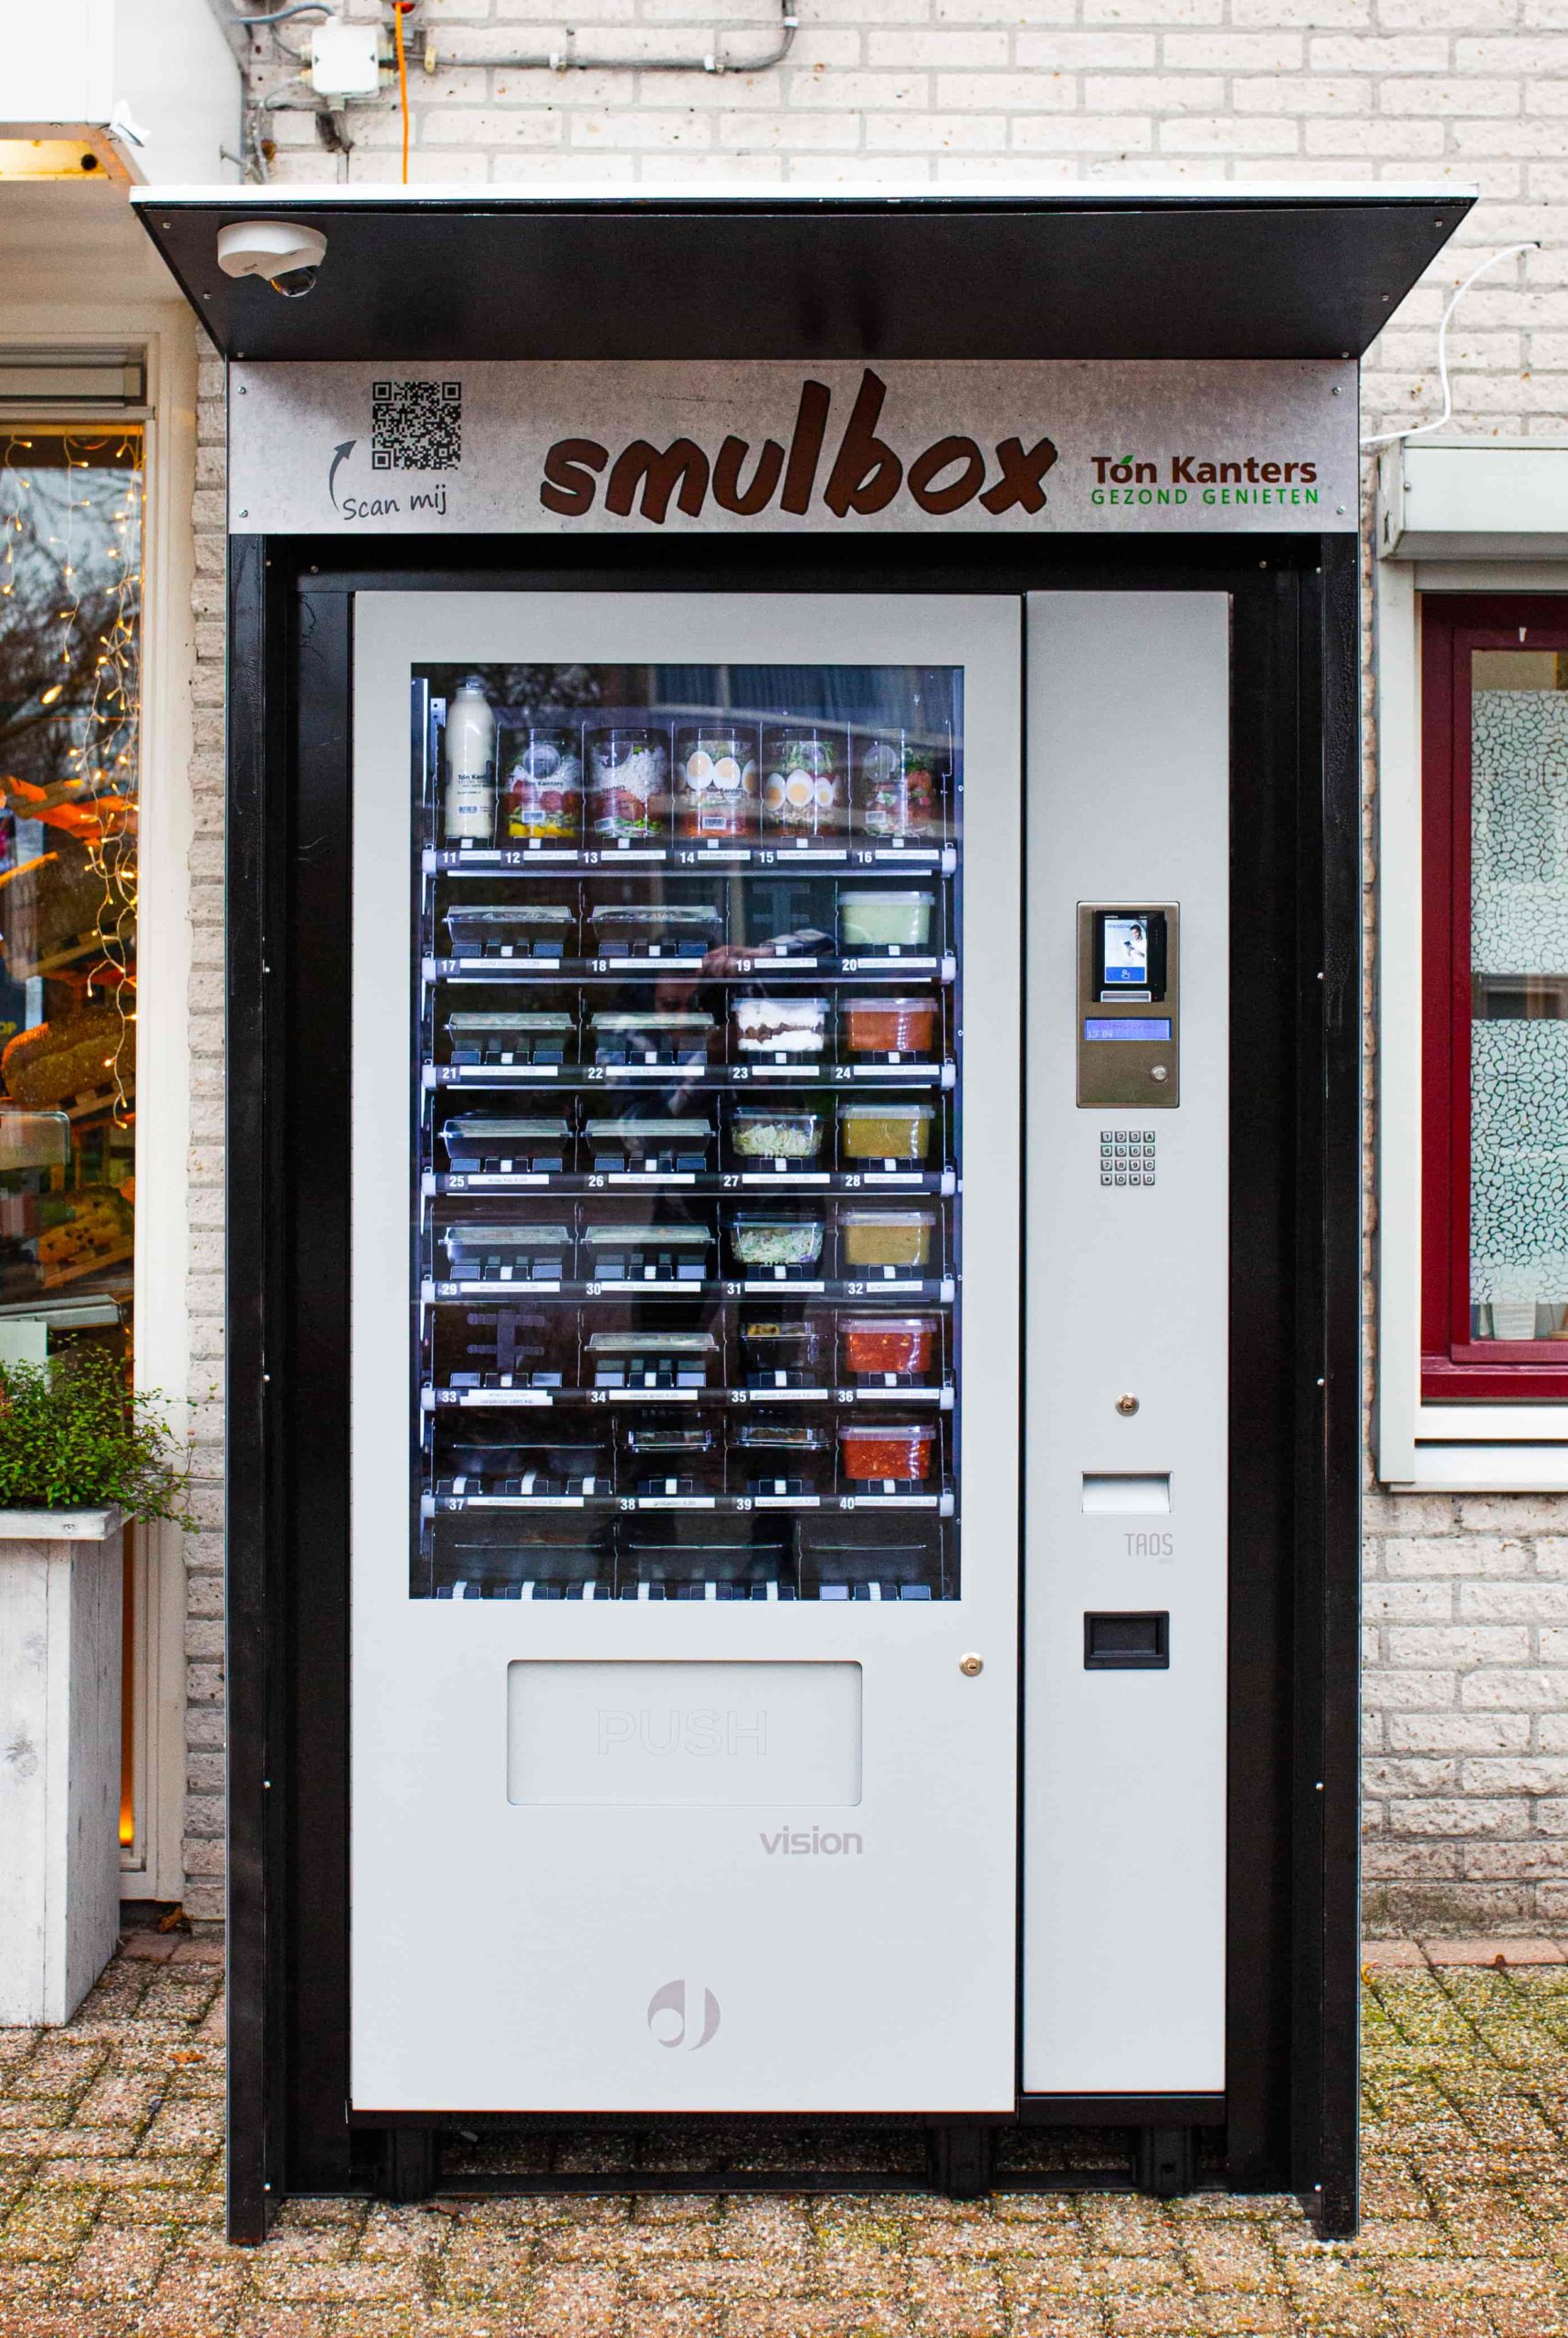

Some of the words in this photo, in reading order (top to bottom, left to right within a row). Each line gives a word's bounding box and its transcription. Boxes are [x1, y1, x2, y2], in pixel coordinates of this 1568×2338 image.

[540, 367, 1058, 525] smulbox
[1172, 456, 1318, 484] Kanters
[1091, 489, 1187, 504] GEZOND
[1203, 489, 1319, 504] GENIETEN
[342, 498, 400, 521] Scan
[410, 484, 447, 515] mij
[443, 852, 456, 863] 11
[506, 852, 520, 863] 12
[584, 852, 597, 863] 13
[680, 852, 694, 863] 14
[759, 852, 773, 863] 15
[858, 851, 872, 862] 16
[441, 960, 456, 972] 17
[592, 960, 606, 971] 18
[736, 960, 751, 971] 19
[843, 959, 857, 971] 20
[442, 1068, 456, 1079] 21
[588, 1068, 603, 1079] 22
[733, 1068, 748, 1079] 23
[836, 1068, 850, 1079] 24
[449, 1175, 464, 1187] 25
[589, 1175, 604, 1186] 26
[724, 1175, 739, 1186] 27
[846, 1175, 860, 1186] 28
[443, 1283, 458, 1295] 29
[586, 1283, 601, 1295] 30
[728, 1283, 741, 1294] 31
[848, 1282, 863, 1294] 32
[442, 1391, 457, 1402] 33
[592, 1392, 605, 1402] 34
[731, 1391, 746, 1402] 35
[838, 1391, 853, 1402] 36
[449, 1498, 464, 1510] 37
[621, 1499, 635, 1510] 38
[737, 1498, 752, 1510] 39
[840, 1498, 854, 1509] 40
[1124, 1532, 1173, 1556] TAOS
[597, 1709, 768, 1756] PUSH
[759, 1825, 863, 1855] vision
